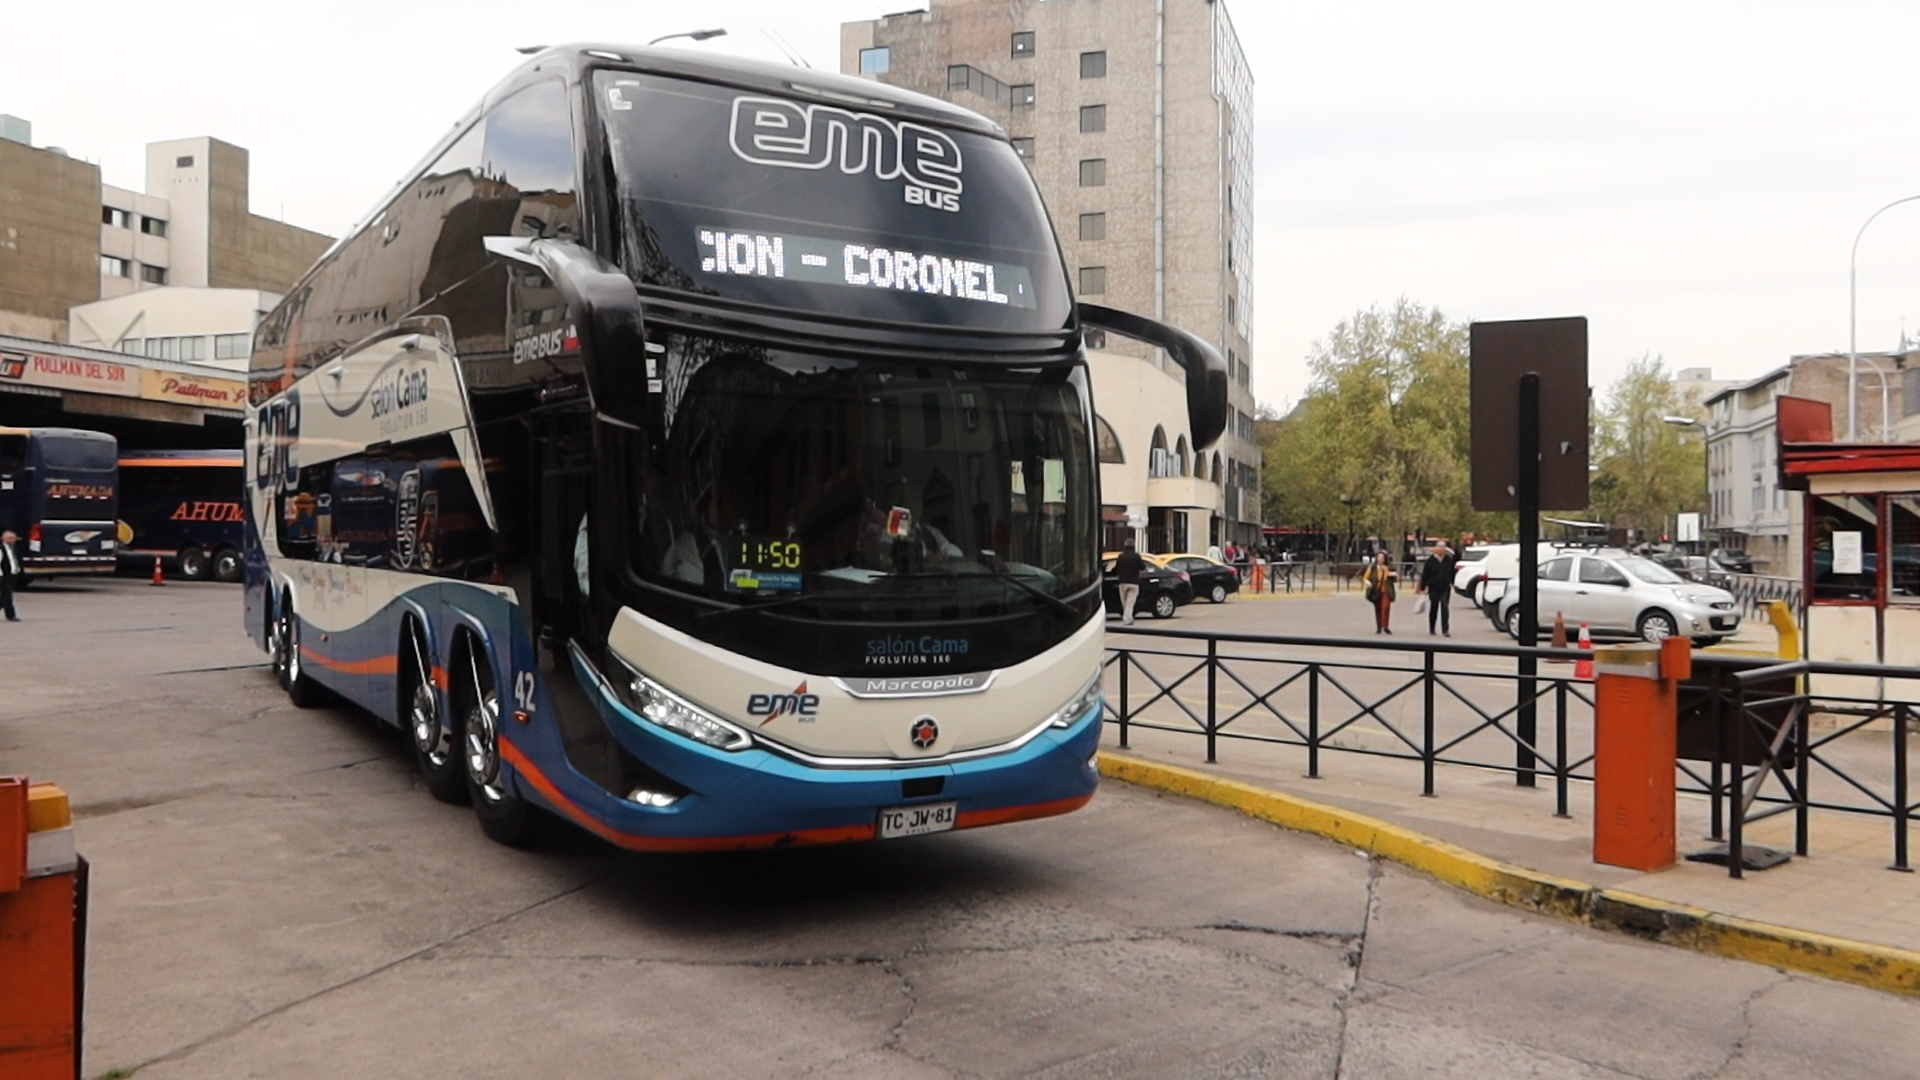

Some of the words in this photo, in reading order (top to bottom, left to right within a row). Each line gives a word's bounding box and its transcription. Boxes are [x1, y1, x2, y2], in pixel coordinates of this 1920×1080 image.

[729, 96, 962, 194] eme
[904, 184, 960, 213] BUS
[844, 244, 1008, 304] CORONEL
[34, 356, 82, 376] PULLMAN
[86, 363, 103, 379] DEL
[107, 365, 125, 381] SUR
[162, 378, 228, 400] Pullman
[397, 368, 427, 409] Cama
[742, 541, 801, 568] 11:50
[867, 634, 915, 655] salón
[919, 636, 969, 653] Cama
[515, 670, 536, 712] 42
[866, 676, 974, 692] Marcopolo
[746, 693, 820, 716] eme
